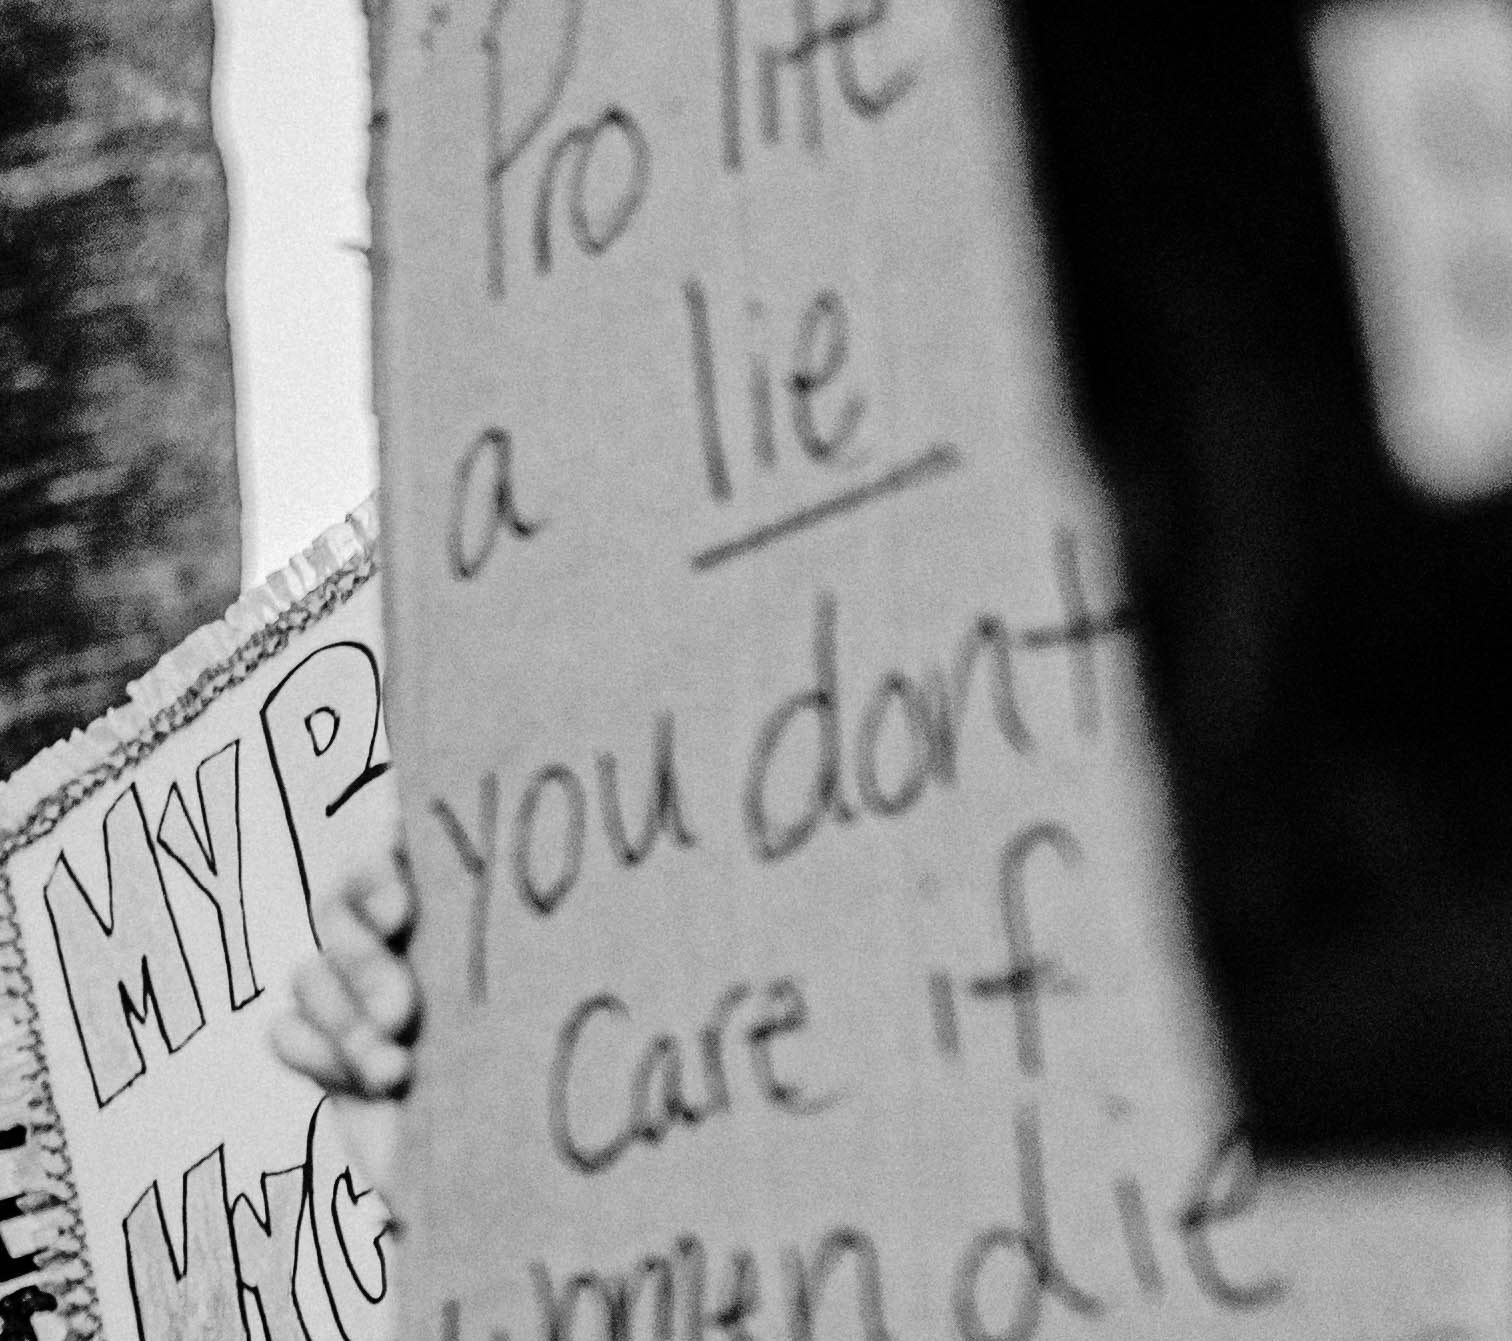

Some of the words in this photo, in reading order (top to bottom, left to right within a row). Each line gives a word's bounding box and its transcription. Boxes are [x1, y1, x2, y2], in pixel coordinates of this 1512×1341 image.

[683, 276, 865, 504] lie
[42, 738, 266, 1107] MY
[431, 712, 697, 1003] you
[922, 817, 1083, 1076] if
